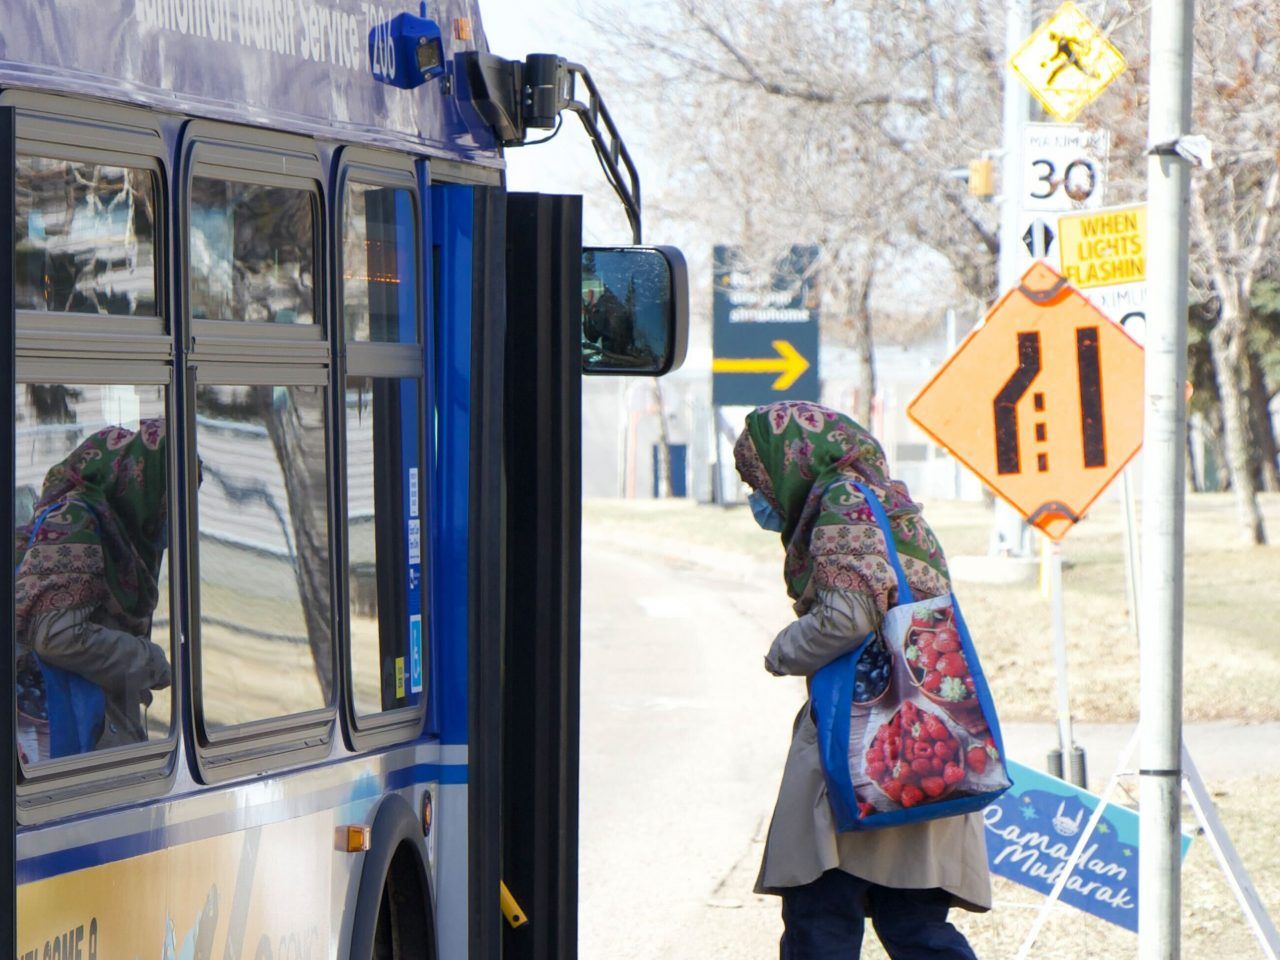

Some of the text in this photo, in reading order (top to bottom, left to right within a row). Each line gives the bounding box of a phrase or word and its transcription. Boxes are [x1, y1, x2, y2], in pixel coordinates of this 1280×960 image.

[362, 3, 396, 80] 7206
[1030, 159, 1095, 201] 30
[1080, 213, 1138, 236] WHEN
[1078, 236, 1142, 261] LIGHTS
[1066, 258, 1144, 284] FLASHIN
